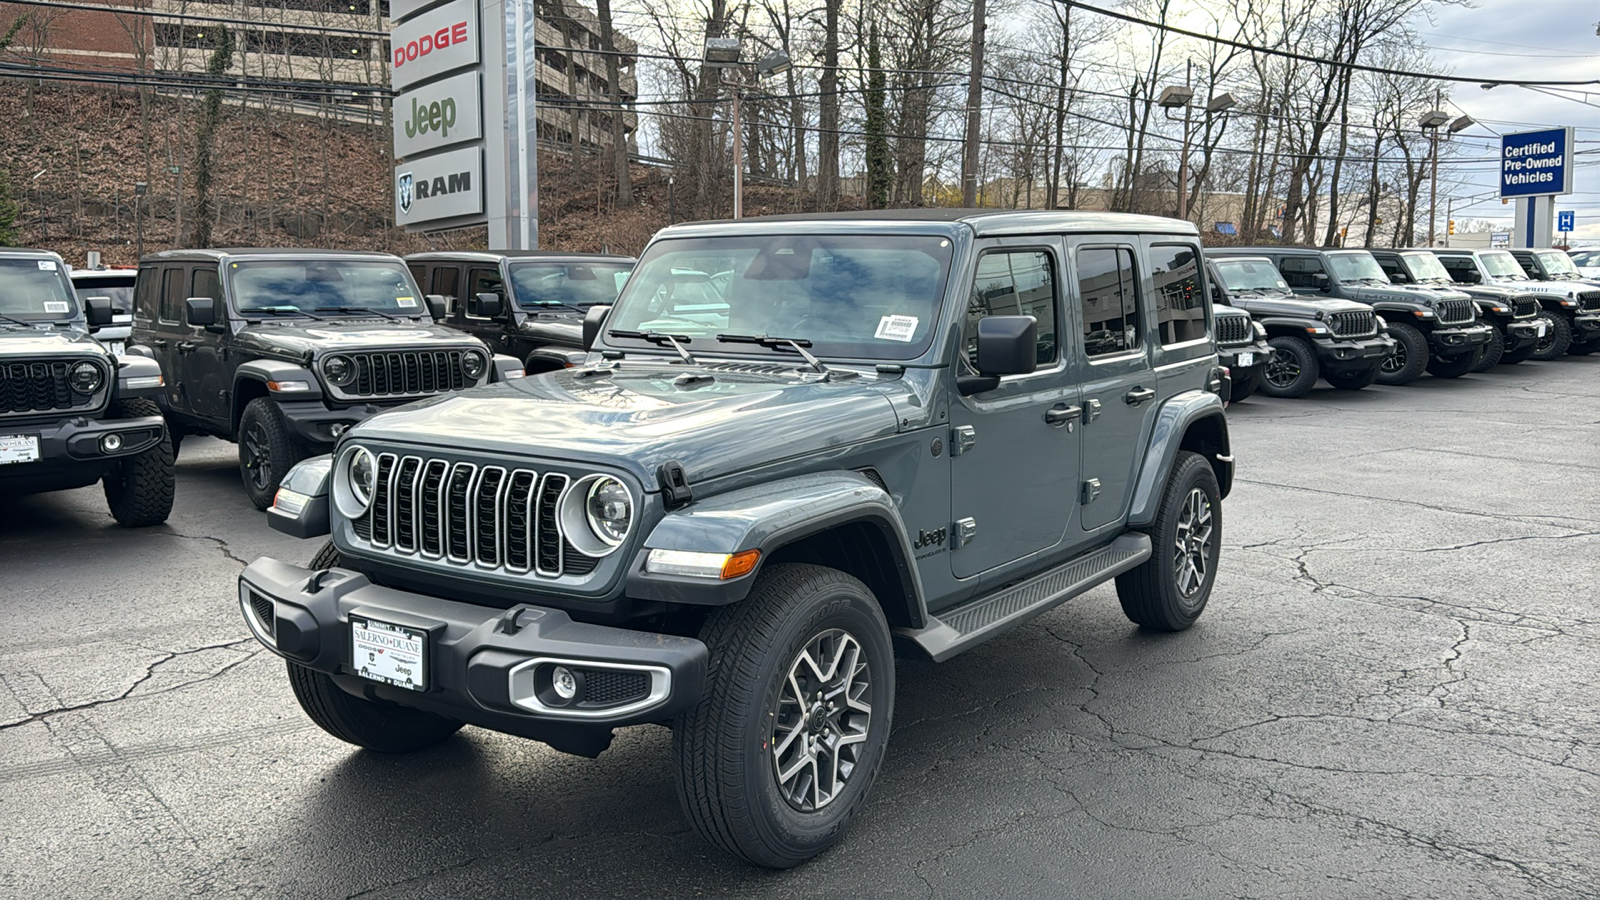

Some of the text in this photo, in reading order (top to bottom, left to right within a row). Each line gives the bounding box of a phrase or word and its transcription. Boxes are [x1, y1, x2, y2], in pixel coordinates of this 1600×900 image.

[394, 21, 468, 68] DODGE
[405, 97, 456, 138] Jeep
[1505, 141, 1555, 158] Certified
[1504, 155, 1562, 171] Pre-Owned
[416, 171, 471, 200] RAM
[1504, 171, 1554, 185] Vehicles
[1561, 215, 1571, 226] H
[914, 527, 947, 550] Jeep
[354, 629, 421, 654] SALERNO DUANE
[358, 671, 385, 682] SALERNO
[394, 664, 412, 677] Jeep
